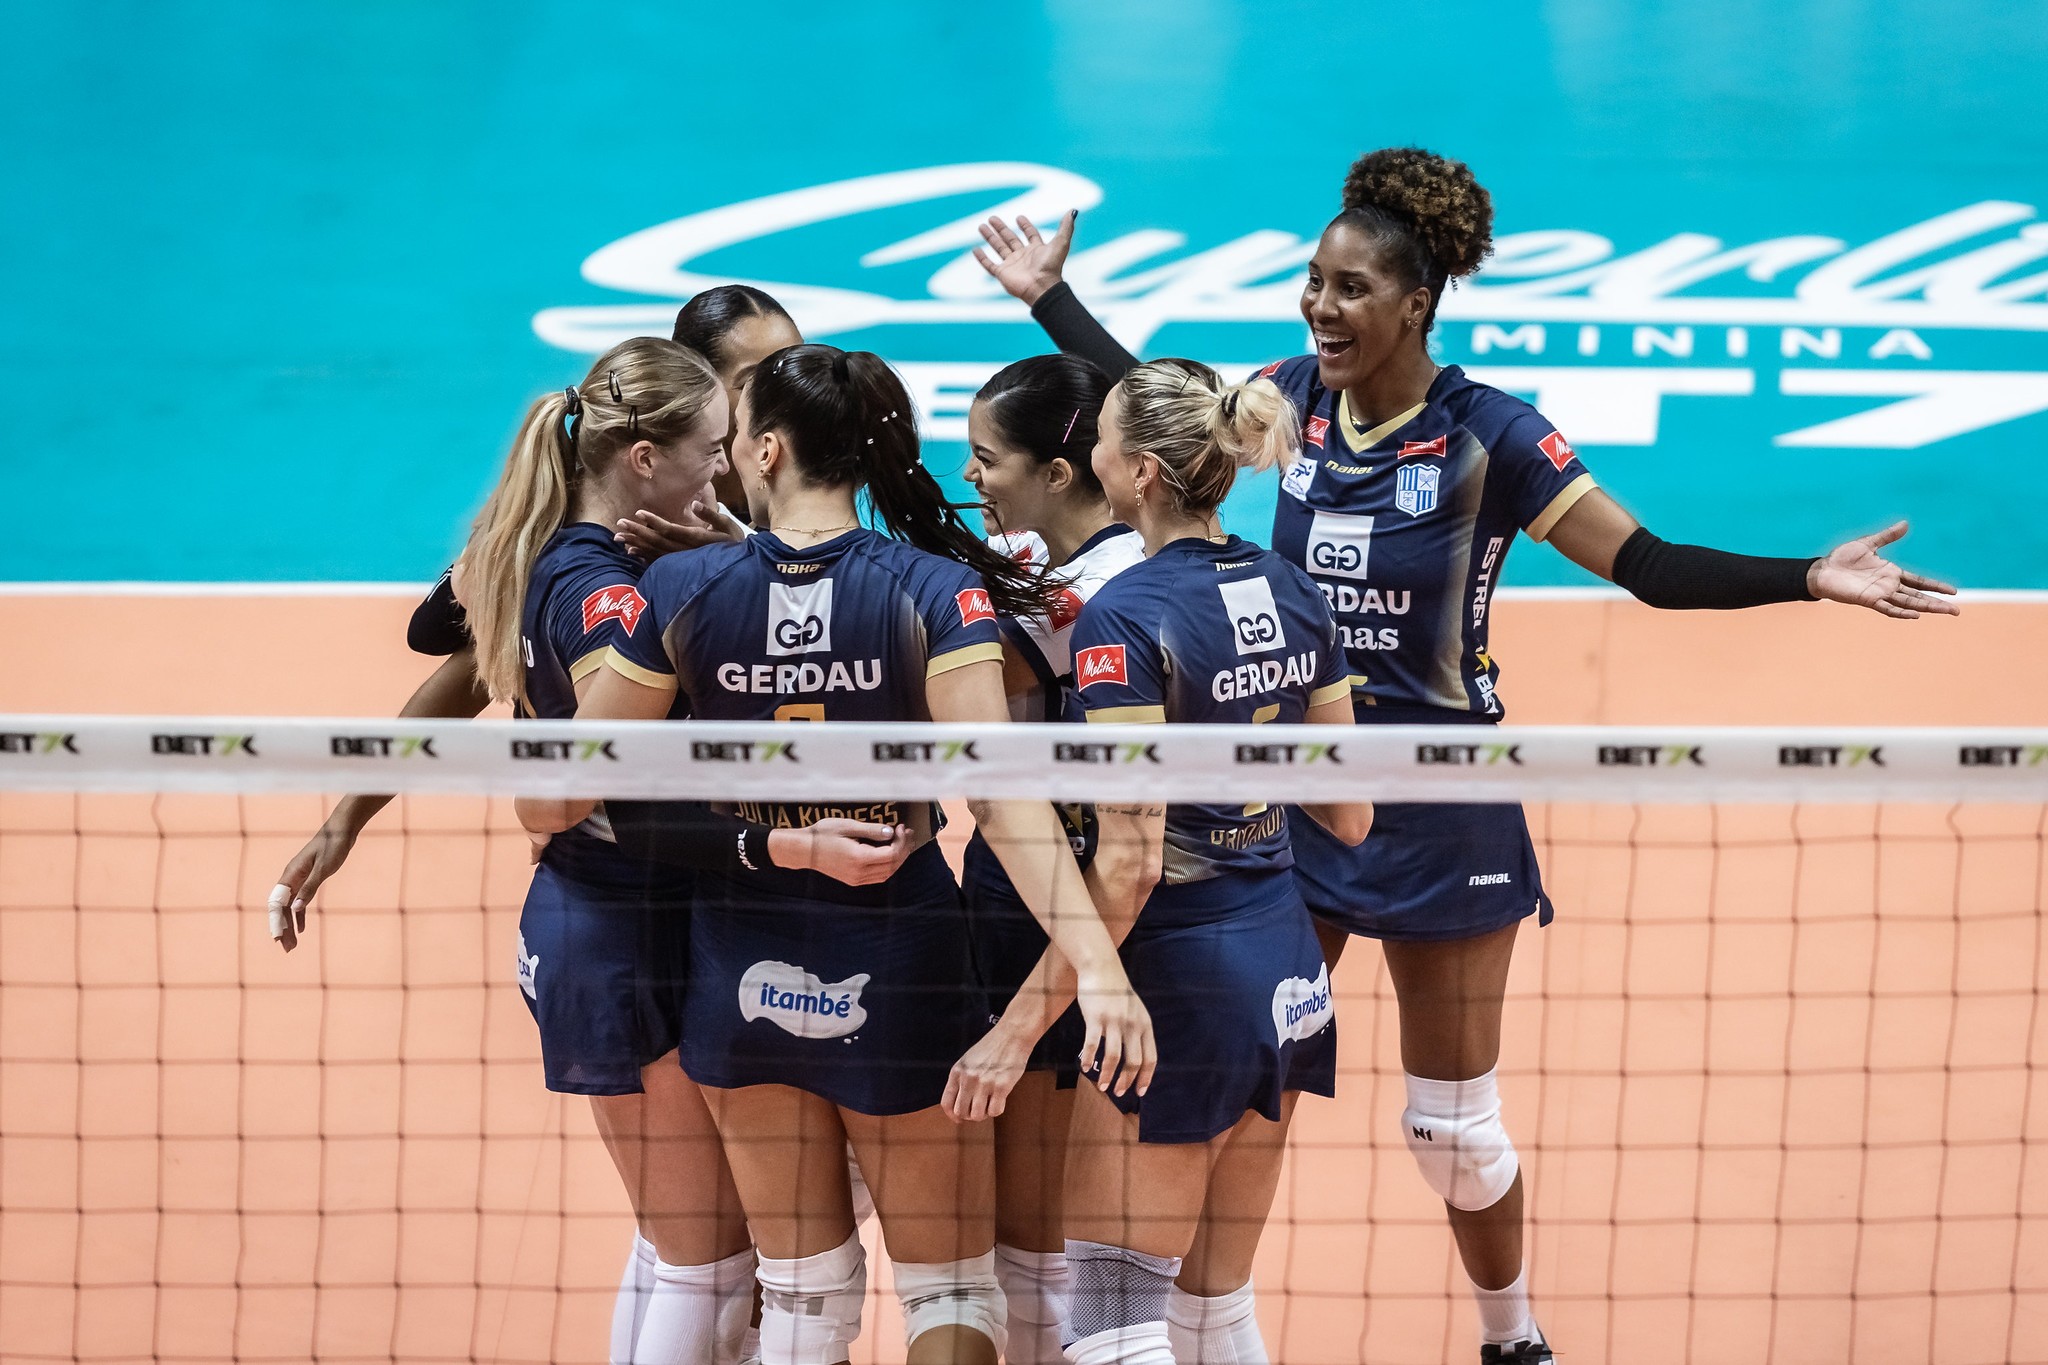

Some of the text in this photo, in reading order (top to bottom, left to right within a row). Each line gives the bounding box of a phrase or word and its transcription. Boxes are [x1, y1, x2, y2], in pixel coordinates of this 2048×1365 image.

[1305, 325, 1934, 360] MININA
[1316, 582, 1411, 615] RDAU
[1338, 624, 1400, 651] nas
[716, 658, 882, 694] GERDAU
[1081, 653, 1117, 679] Melitta
[1211, 650, 1317, 703] GERDAU
[0, 733, 80, 755] ET7K
[151, 735, 258, 757] BET7K
[330, 736, 438, 759] BET7K
[510, 738, 618, 761] BET7K
[690, 740, 799, 763] BET7K
[871, 741, 980, 763] BET7K
[1053, 742, 1161, 764] BET7K
[1234, 744, 1343, 765] BET7K
[1415, 744, 1524, 766] BET7K
[1597, 745, 1705, 767] BET7K
[1778, 746, 1886, 768] BET7K
[760, 982, 852, 1019] itambé
[1286, 985, 1327, 1028] itambé
